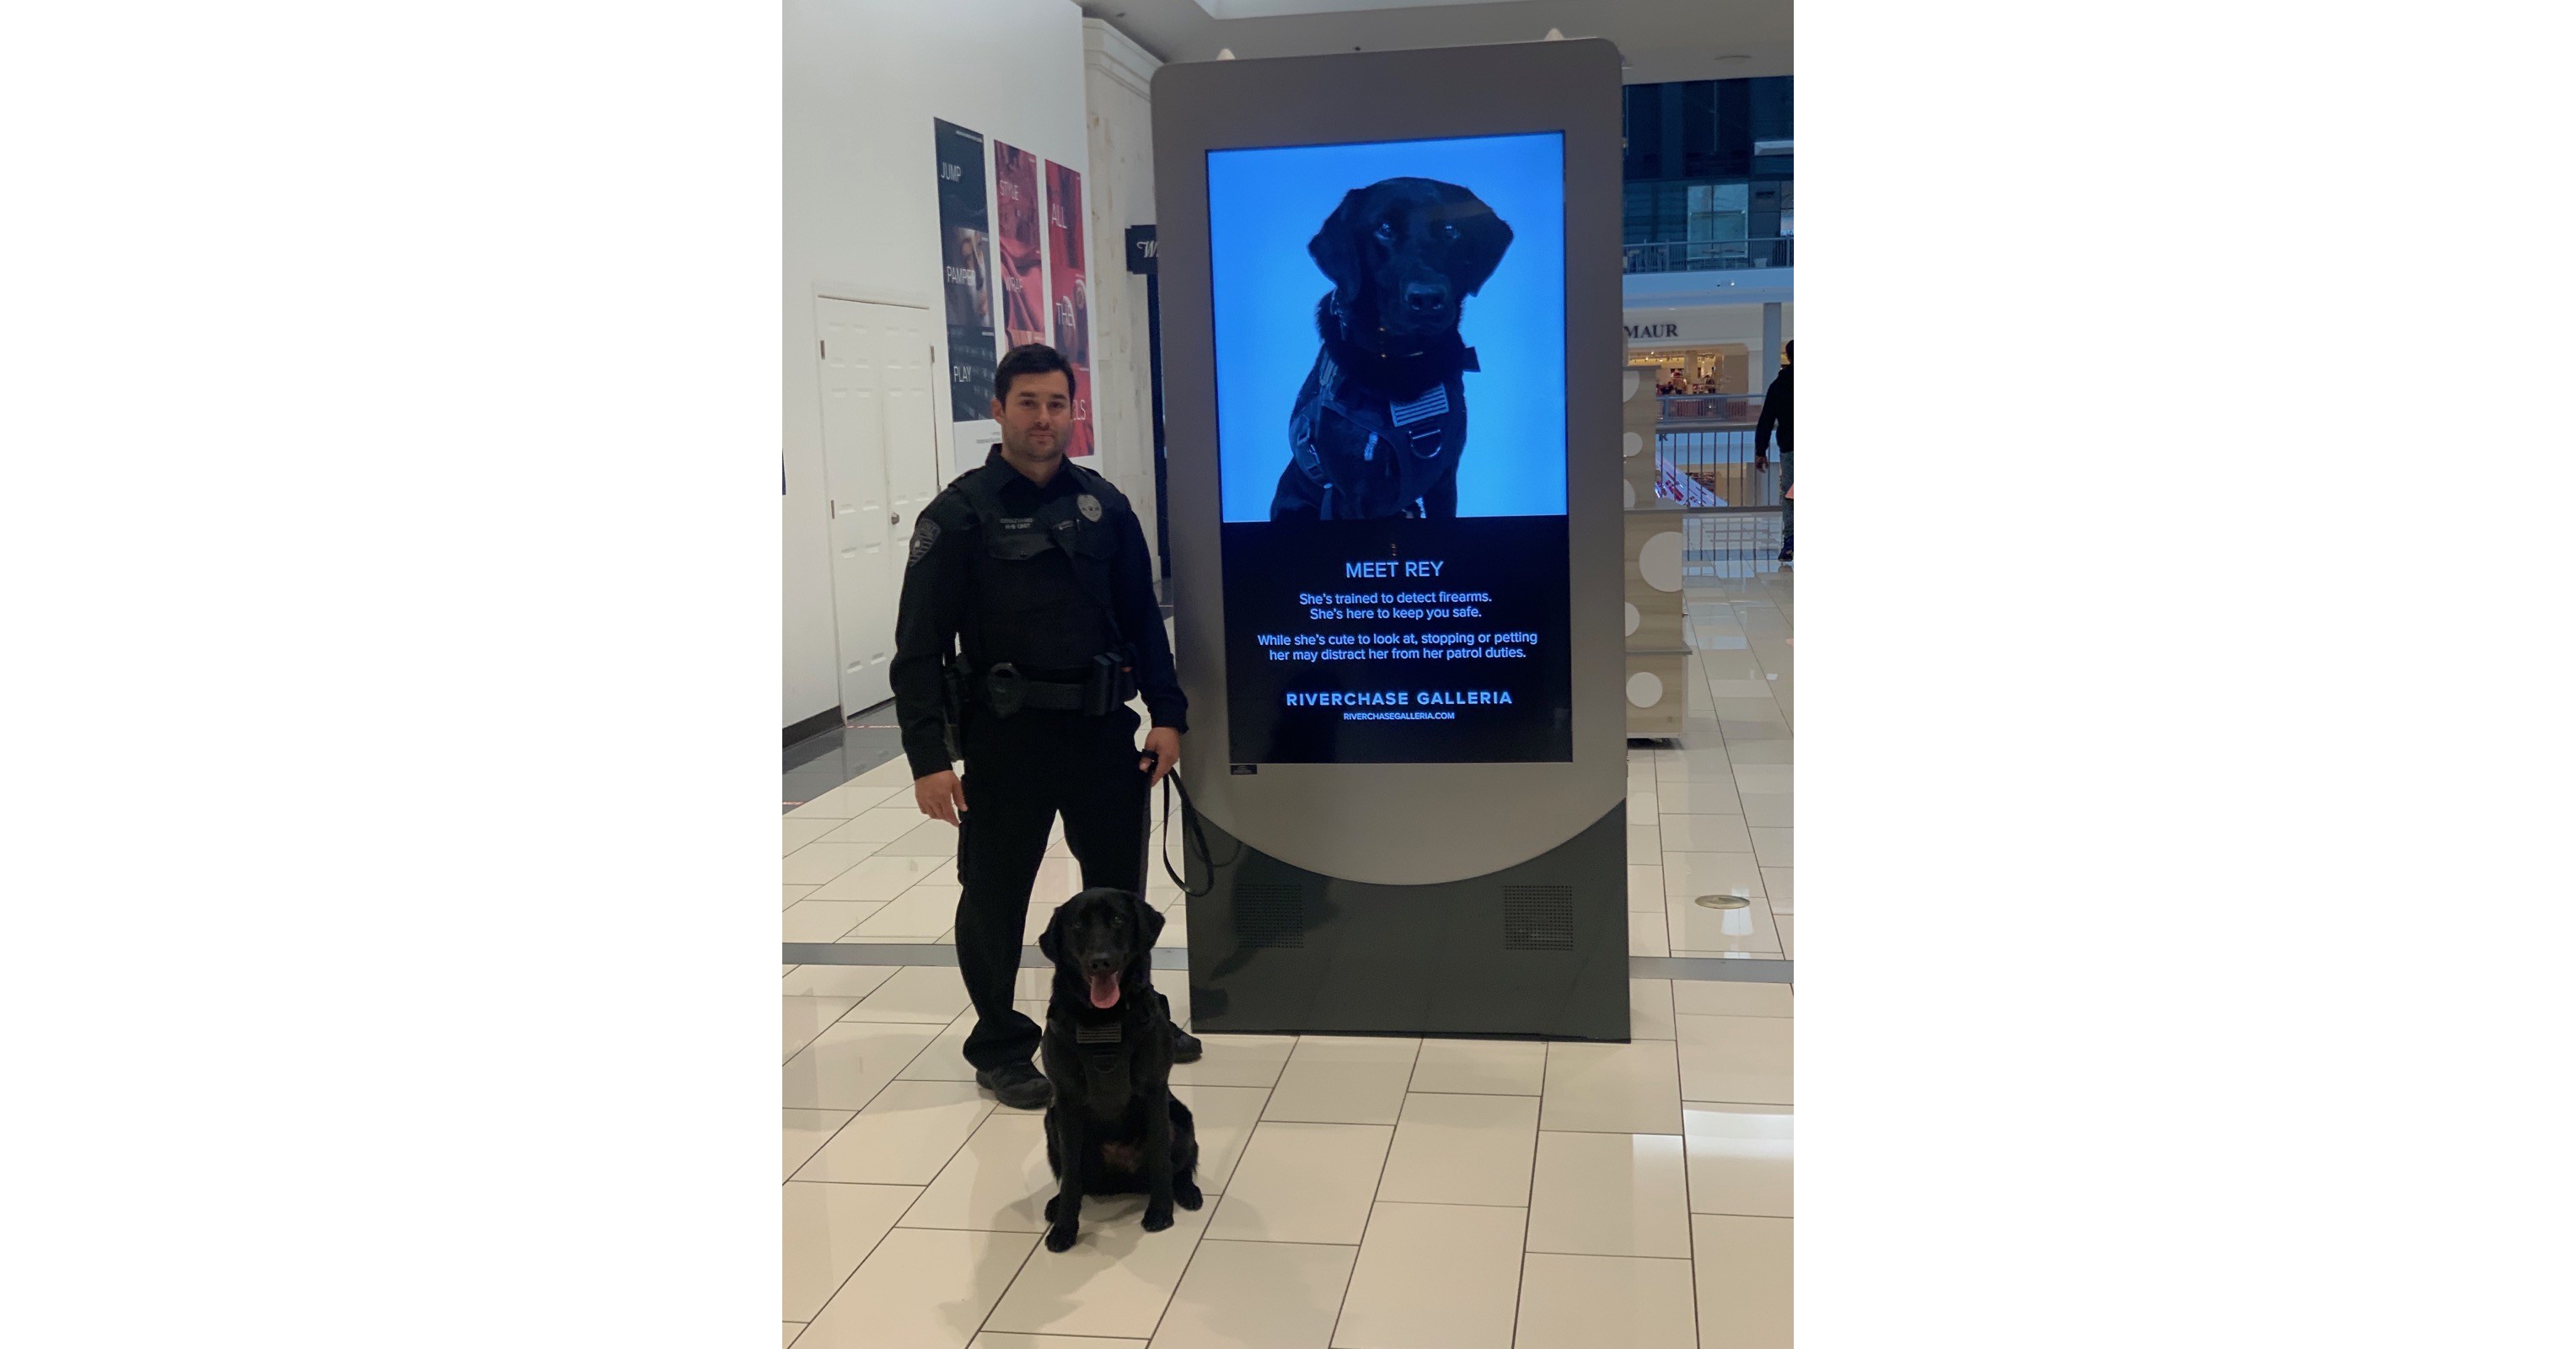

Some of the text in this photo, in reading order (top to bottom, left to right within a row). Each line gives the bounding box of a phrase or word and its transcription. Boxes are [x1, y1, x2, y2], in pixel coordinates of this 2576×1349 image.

[941, 161, 962, 182] JUMP
[1051, 202, 1067, 229] ALL
[947, 266, 976, 287] PAMPER
[1623, 324, 1679, 339] MAUR
[953, 365, 972, 383] PLAY
[1346, 560, 1444, 578] MEET REY
[1299, 590, 1492, 605] She's trained to detect firearms.
[1310, 605, 1482, 621] She's here to keep you safe.
[1258, 632, 1538, 646] While she's cute to look at, stopping or petting
[1269, 646, 1526, 663] her may distract her from her patrol duties.
[1286, 690, 1512, 706] RIVERCHASE GALLERIA
[1344, 711, 1455, 720] RIVERCHASEGALLERIA.COM
